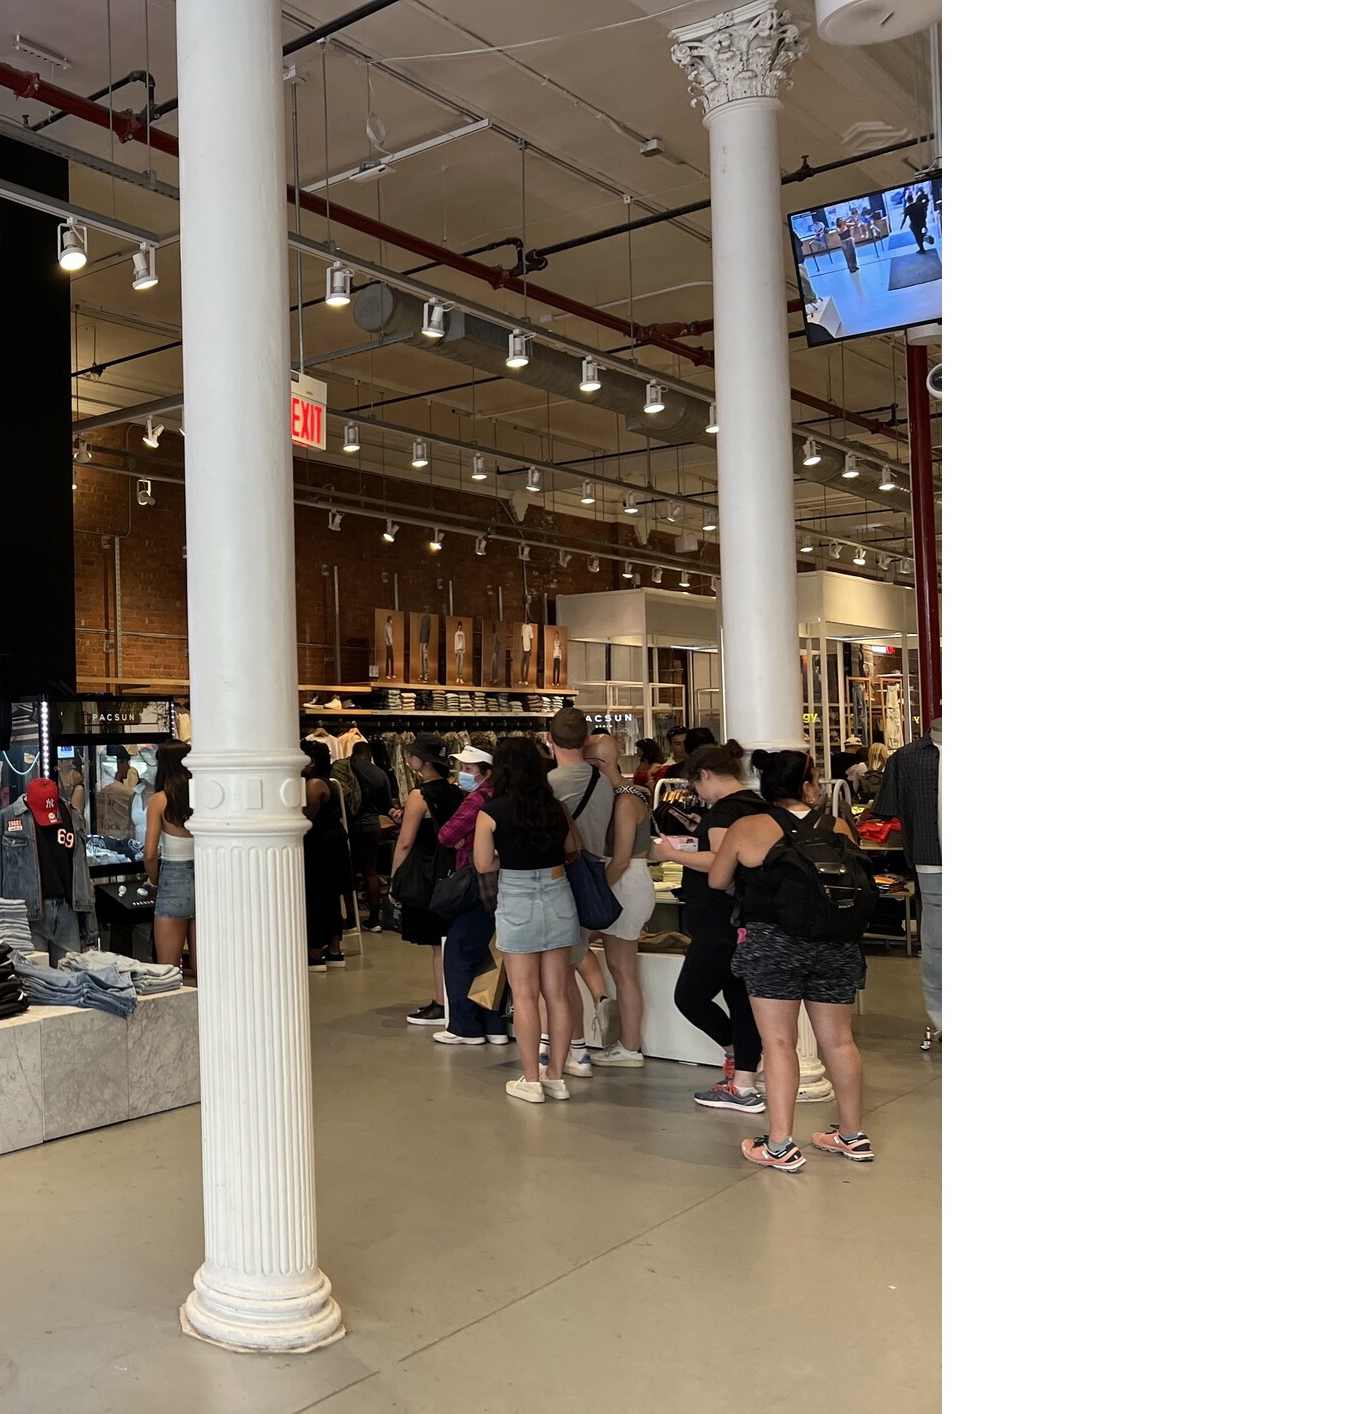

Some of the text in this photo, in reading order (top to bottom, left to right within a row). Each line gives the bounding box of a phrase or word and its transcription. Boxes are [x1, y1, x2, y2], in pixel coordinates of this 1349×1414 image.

[291, 397, 323, 444] EXIT
[92, 713, 135, 721] PACSUN
[585, 713, 632, 722] ACSUN
[57, 828, 74, 848] 69
